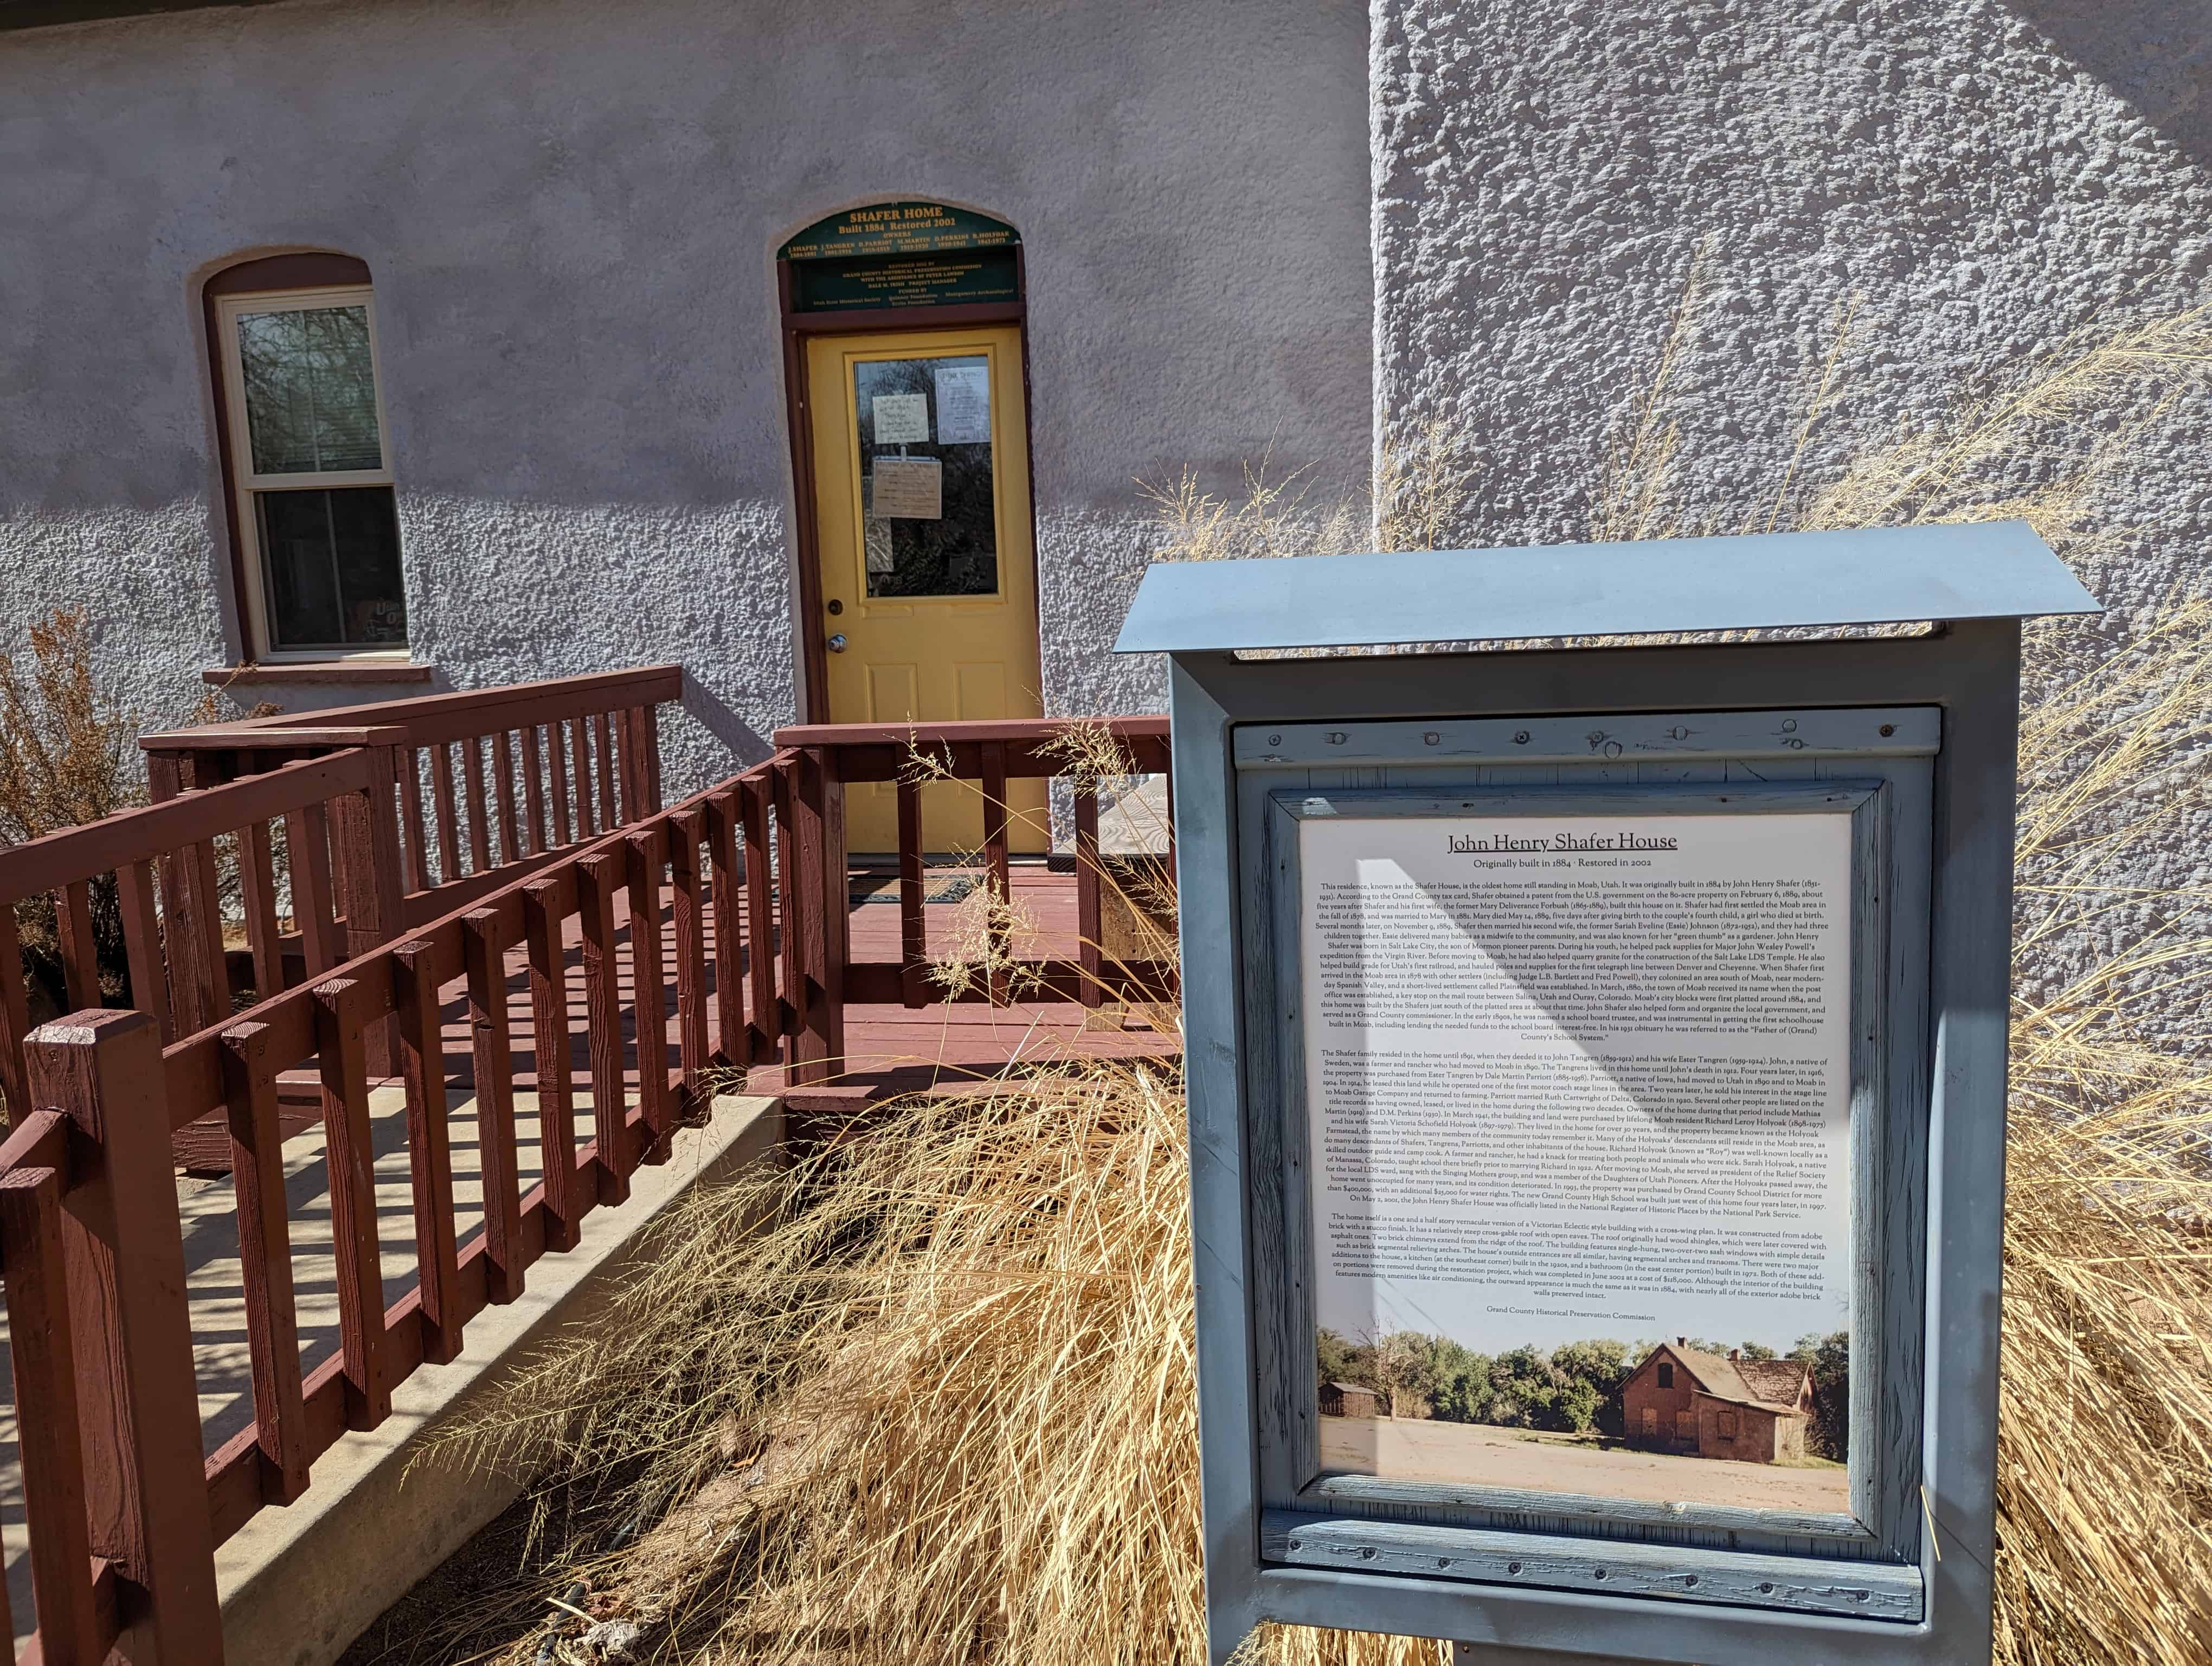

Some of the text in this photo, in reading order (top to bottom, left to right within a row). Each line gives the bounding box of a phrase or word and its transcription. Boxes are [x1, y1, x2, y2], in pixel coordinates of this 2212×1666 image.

[850, 207, 943, 223] SHAFER HOME
[839, 225, 862, 234] Built
[890, 220, 931, 230] Restored
[934, 218, 955, 227] 2002
[1448, 832, 1677, 853] John Henry Shafer House
[1473, 858, 1517, 870] Originally
[1519, 858, 1540, 868] built
[1541, 858, 1551, 868] in
[1552, 858, 1572, 868] 1884
[1578, 857, 1618, 867] Restored
[1619, 858, 1629, 867] in
[1336, 882, 1369, 890] residence,
[1414, 881, 1437, 889] Shafer
[1438, 882, 1461, 890] House,
[1469, 881, 1481, 889] the
[1481, 881, 1502, 889] oldest
[1503, 881, 1523, 889] home
[1524, 881, 1536, 889] still
[1538, 880, 1568, 890] standing
[1577, 880, 1599, 889] Moab,
[1600, 880, 1621, 888] Utah.
[1622, 880, 1628, 888] It
[1643, 880, 1677, 889] originally
[1678, 880, 1696, 888] built
[1706, 880, 1721, 889] 1884
[1722, 879, 1732, 889] by
[1732, 879, 1750, 889] John
[1751, 879, 1774, 889] Henry
[1776, 879, 1801, 887] Shafer
[1801, 879, 1821, 889] (1851-
[1320, 960, 1342, 970] helped
[1342, 961, 1360, 969] build
[1361, 962, 1379, 970] grade
[1429, 962, 1457, 970] railroad,
[1496, 962, 1514, 971] poles
[1514, 962, 1527, 970] and
[1528, 962, 1557, 972] supplies
[1557, 962, 1568, 970] for
[1581, 963, 1596, 971] first
[1597, 963, 1629, 972] telegraph
[1630, 963, 1644, 971] line
[1645, 963, 1675, 971] between
[1676, 963, 1703, 971] Denver
[1704, 963, 1718, 971] and
[1718, 963, 1758, 972] Cheyenne.
[1759, 963, 1783, 972] When
[1784, 963, 1809, 972] Shafer
[1810, 963, 1825, 972] first
[1520, 1033, 1609, 1042] County's School System."
[1361, 1194, 1376, 1203] May
[1429, 1197, 1449, 1206] Henry
[1473, 1199, 1495, 1207] House
[1509, 1200, 1539, 1209] officially
[1567, 1202, 1578, 1210] the
[1579, 1203, 1609, 1211] National
[1610, 1204, 1639, 1213] Register
[1639, 1204, 1648, 1213] of
[1648, 1206, 1676, 1214] Historic
[1677, 1206, 1699, 1214] Places
[1700, 1207, 1708, 1215] by
[1722, 1208, 1754, 1216] National
[1754, 1209, 1771, 1218] Park
[1772, 1210, 1801, 1219] Service.
[1345, 1213, 1364, 1221] home
[1564, 1222, 1590, 1230] Eclectic
[1591, 1223, 1607, 1232] style
[1607, 1223, 1637, 1233] building
[1637, 1225, 1653, 1233] with
[1660, 1227, 1697, 1236] cross-wing
[1698, 1227, 1716, 1236] plan.
[1782, 1231, 1799, 1239] from
[1801, 1232, 1823, 1240] adobe
[1509, 1306, 1535, 1315] County
[1536, 1308, 1568, 1316] Historical
[1570, 1310, 1611, 1319] Preservation
[1612, 1312, 1656, 1321] Commission
